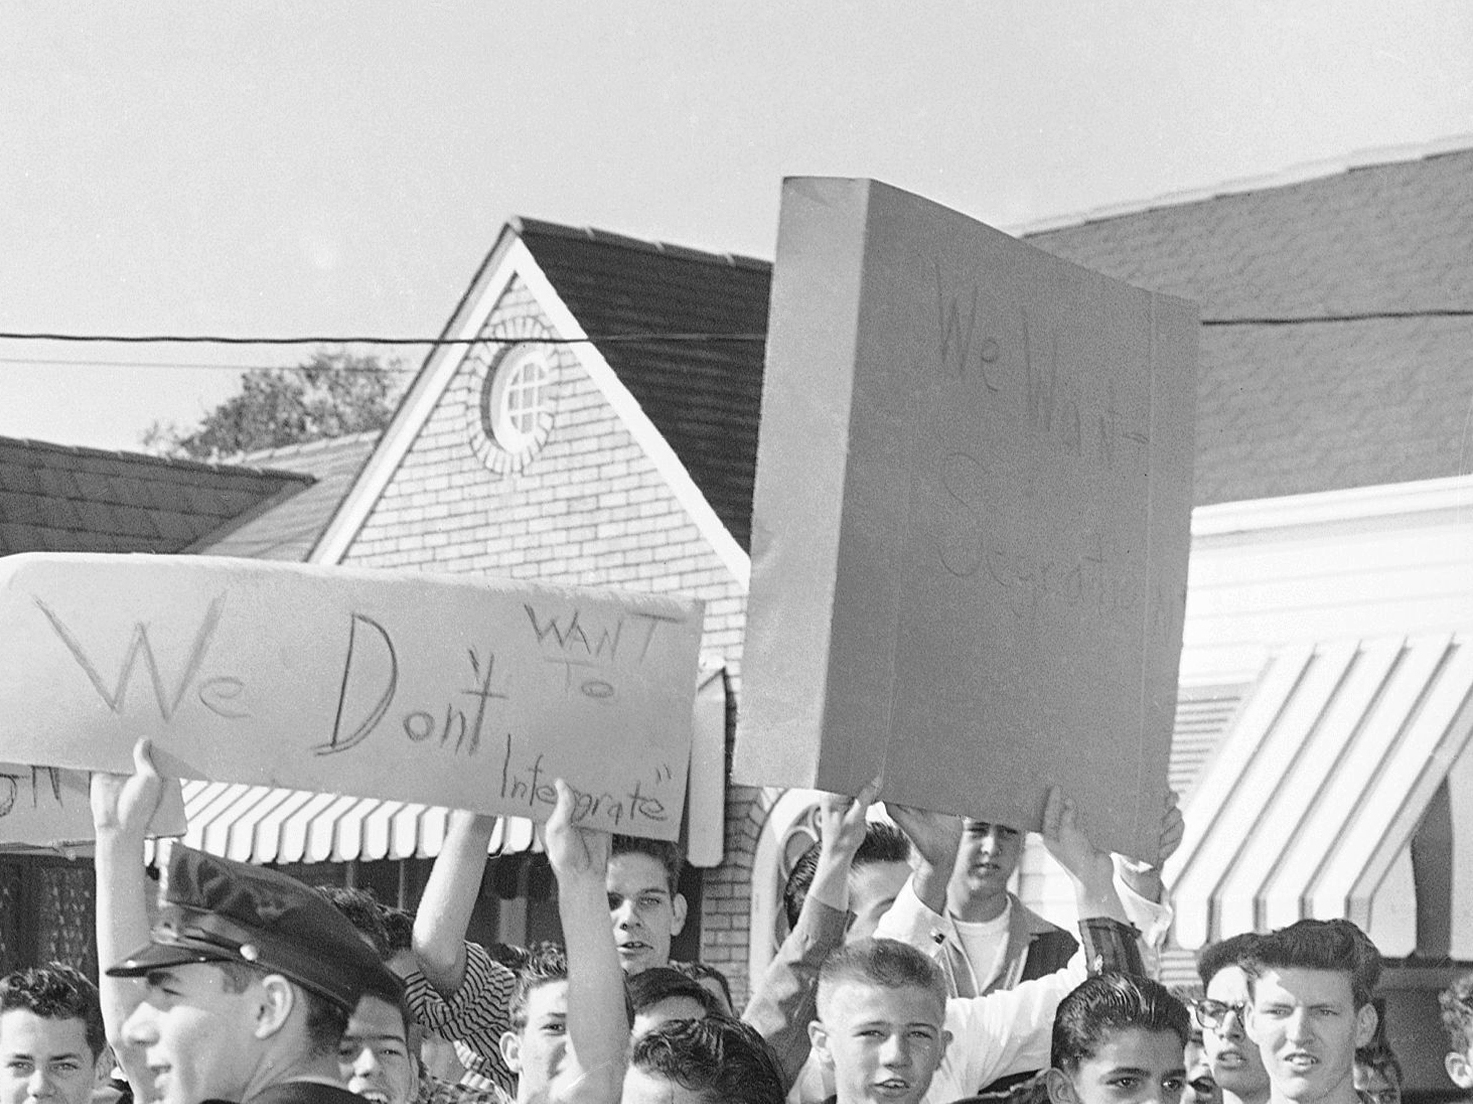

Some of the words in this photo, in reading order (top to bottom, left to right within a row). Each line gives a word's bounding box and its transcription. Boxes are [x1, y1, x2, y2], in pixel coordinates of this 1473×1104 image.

[933, 262, 1000, 393] We
[33, 590, 251, 722] We
[524, 603, 688, 667] WANT
